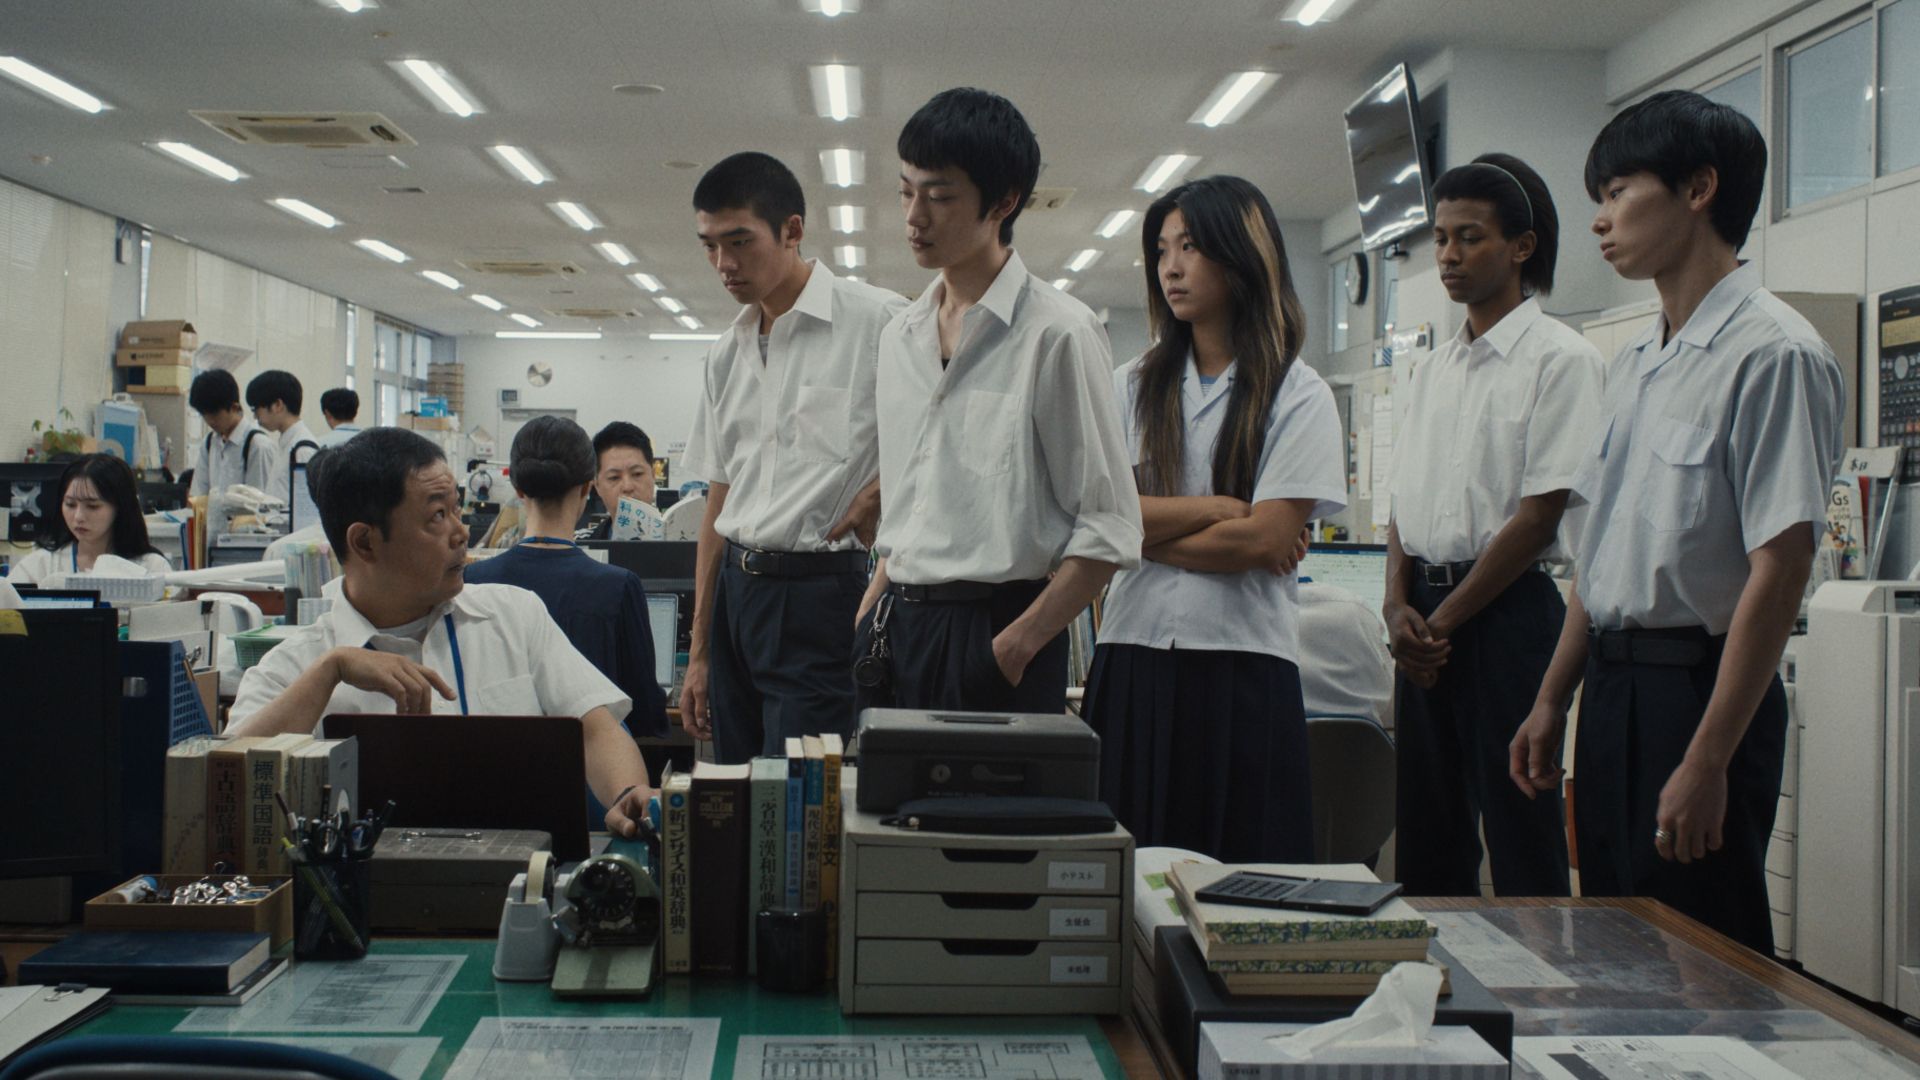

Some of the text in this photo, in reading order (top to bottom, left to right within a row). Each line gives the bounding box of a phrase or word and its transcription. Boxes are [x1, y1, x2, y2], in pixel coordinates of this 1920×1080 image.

[1831, 491, 1850, 506] Gs
[616, 500, 632, 528] 科学
[635, 508, 646, 520] の
